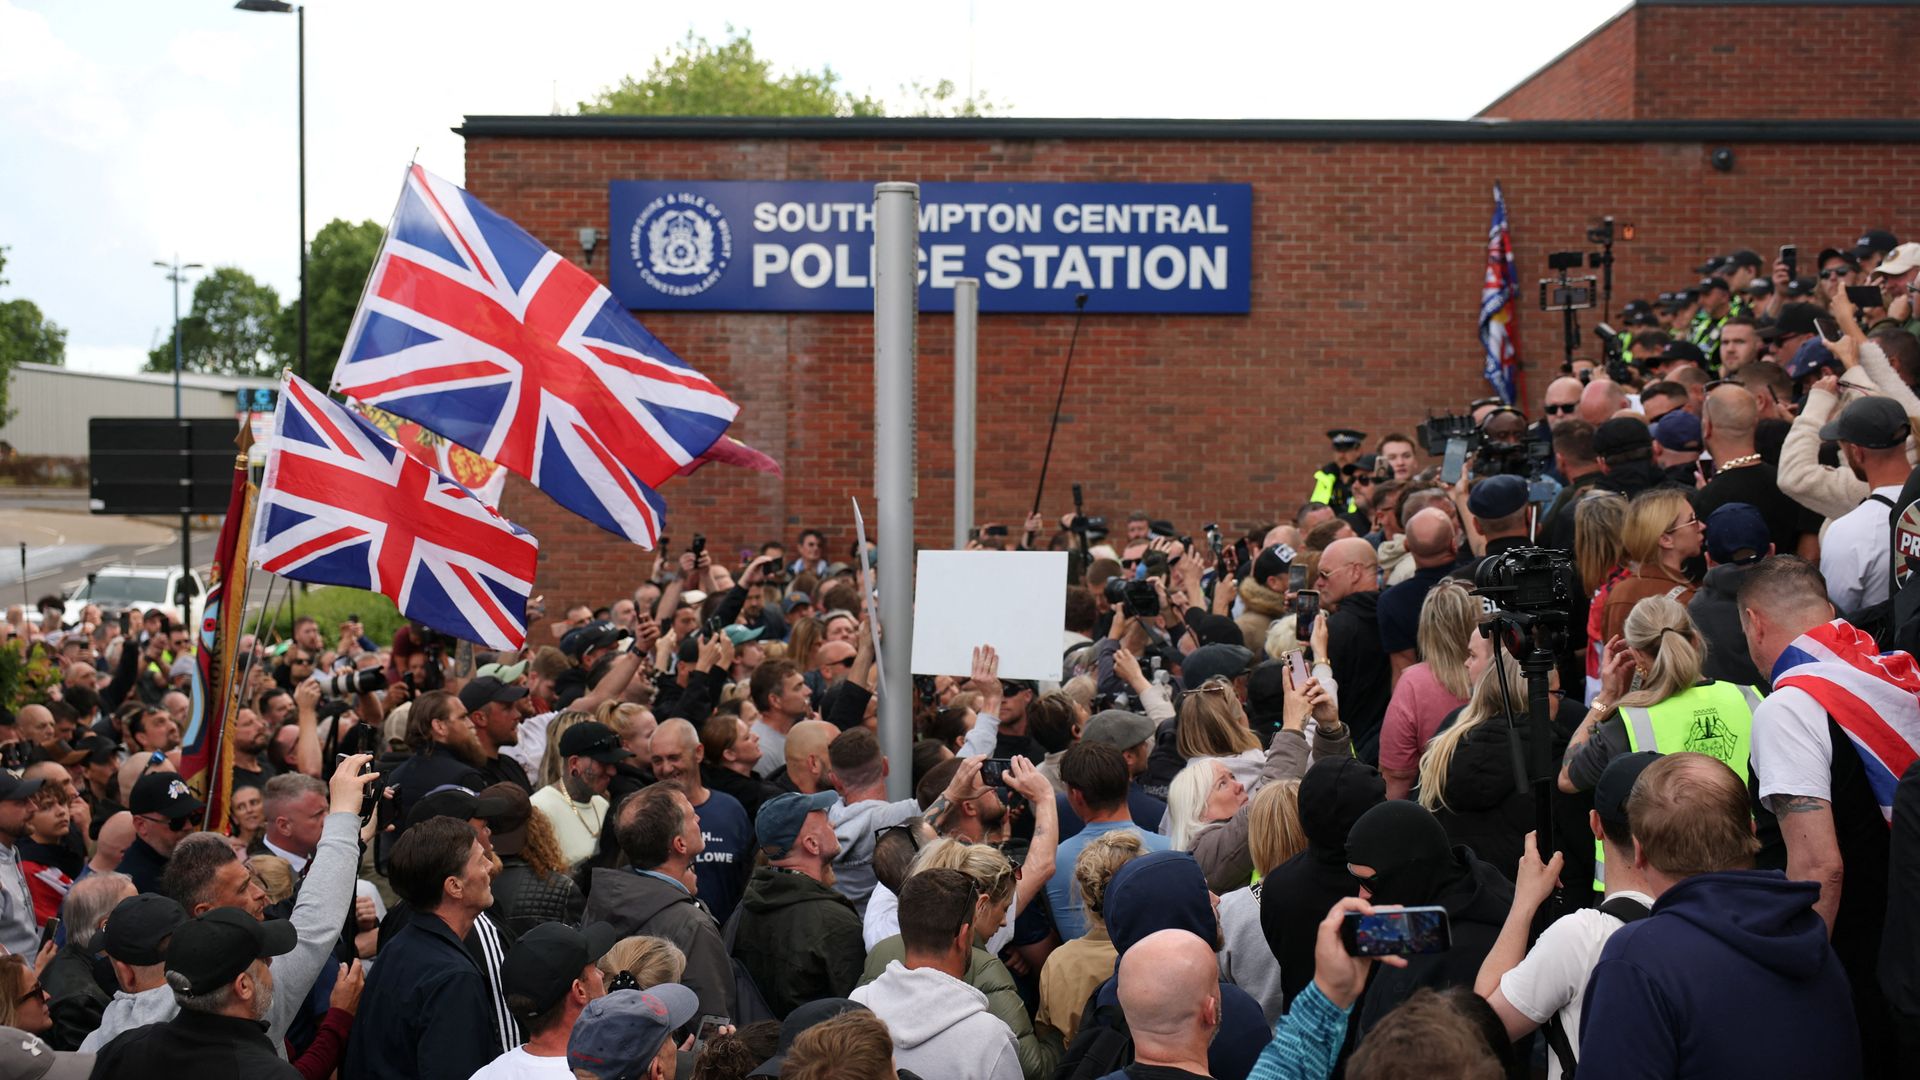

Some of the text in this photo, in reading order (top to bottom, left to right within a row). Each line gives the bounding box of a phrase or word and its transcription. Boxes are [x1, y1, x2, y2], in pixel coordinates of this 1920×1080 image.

[753, 202, 1229, 234] SOUTHMPTON CENTRAL
[984, 244, 1228, 291] STATION
